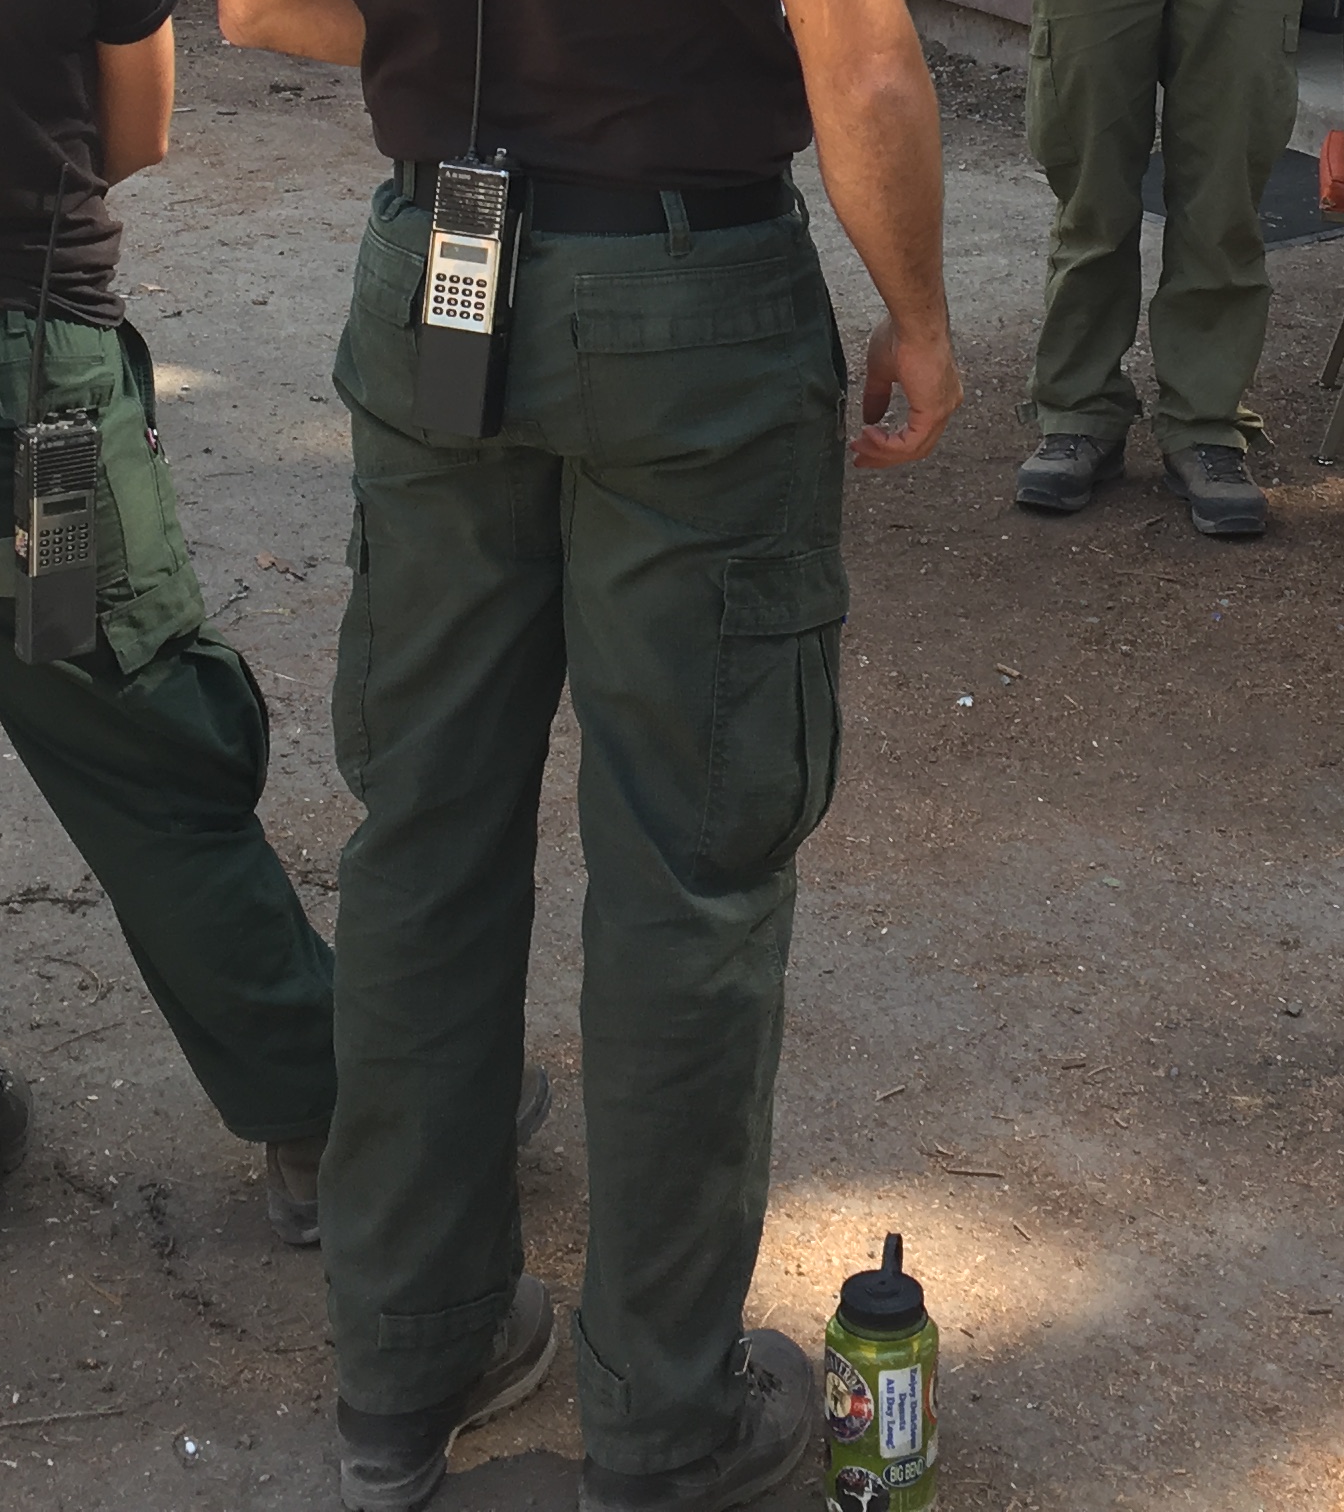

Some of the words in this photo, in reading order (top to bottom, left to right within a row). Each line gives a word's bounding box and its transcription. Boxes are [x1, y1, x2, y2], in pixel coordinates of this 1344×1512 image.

[886, 1378, 895, 1394] All
[885, 1397, 895, 1418] Day
[890, 1464, 904, 1483] BIG
